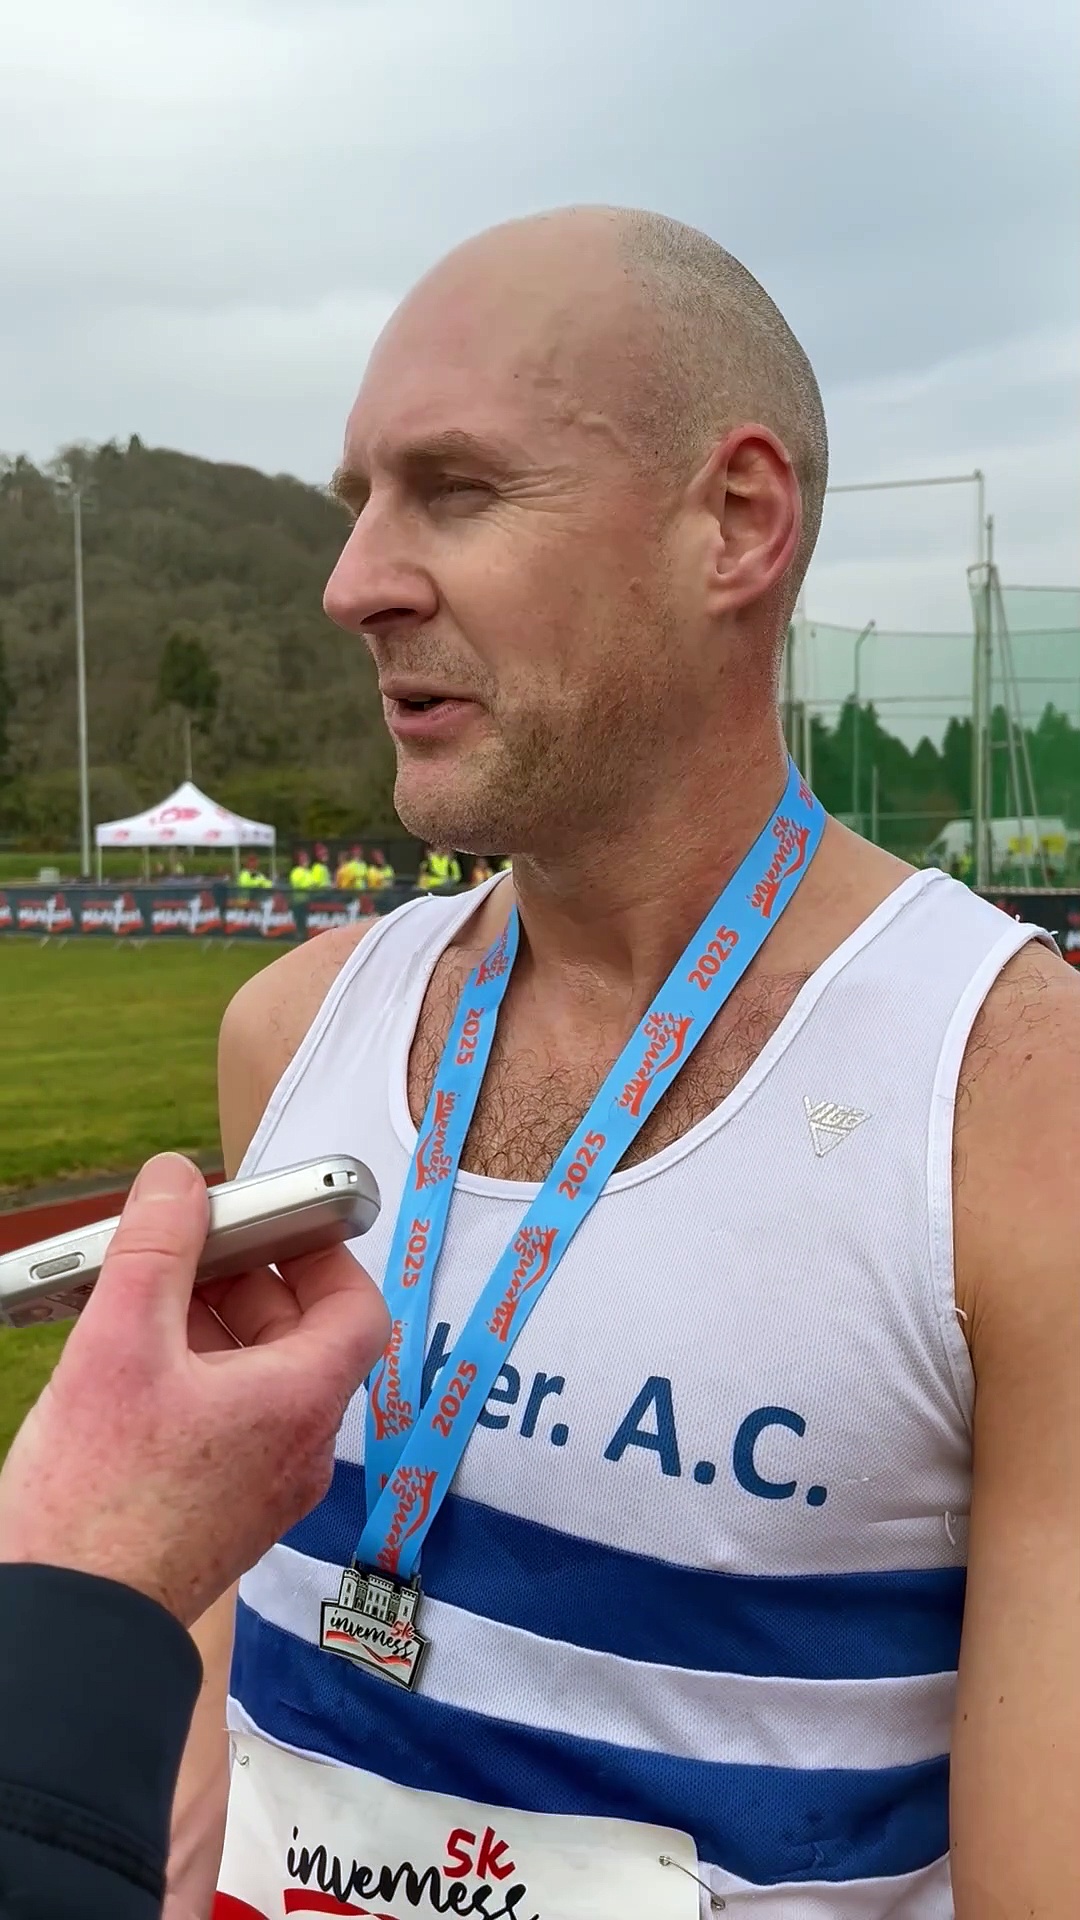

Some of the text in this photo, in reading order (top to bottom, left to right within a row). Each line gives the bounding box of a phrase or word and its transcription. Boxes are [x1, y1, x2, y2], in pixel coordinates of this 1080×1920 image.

[688, 925, 740, 991] 2025
[457, 1007, 486, 1065] 2025
[558, 1130, 608, 1201] 2025
[402, 1218, 431, 1289] 2025
[431, 1359, 478, 1439] 2025
[603, 1375, 828, 1507] A.C.
[330, 1609, 413, 1659] inverness
[286, 1825, 540, 1920] inverness
[442, 1825, 516, 1881] 5k
